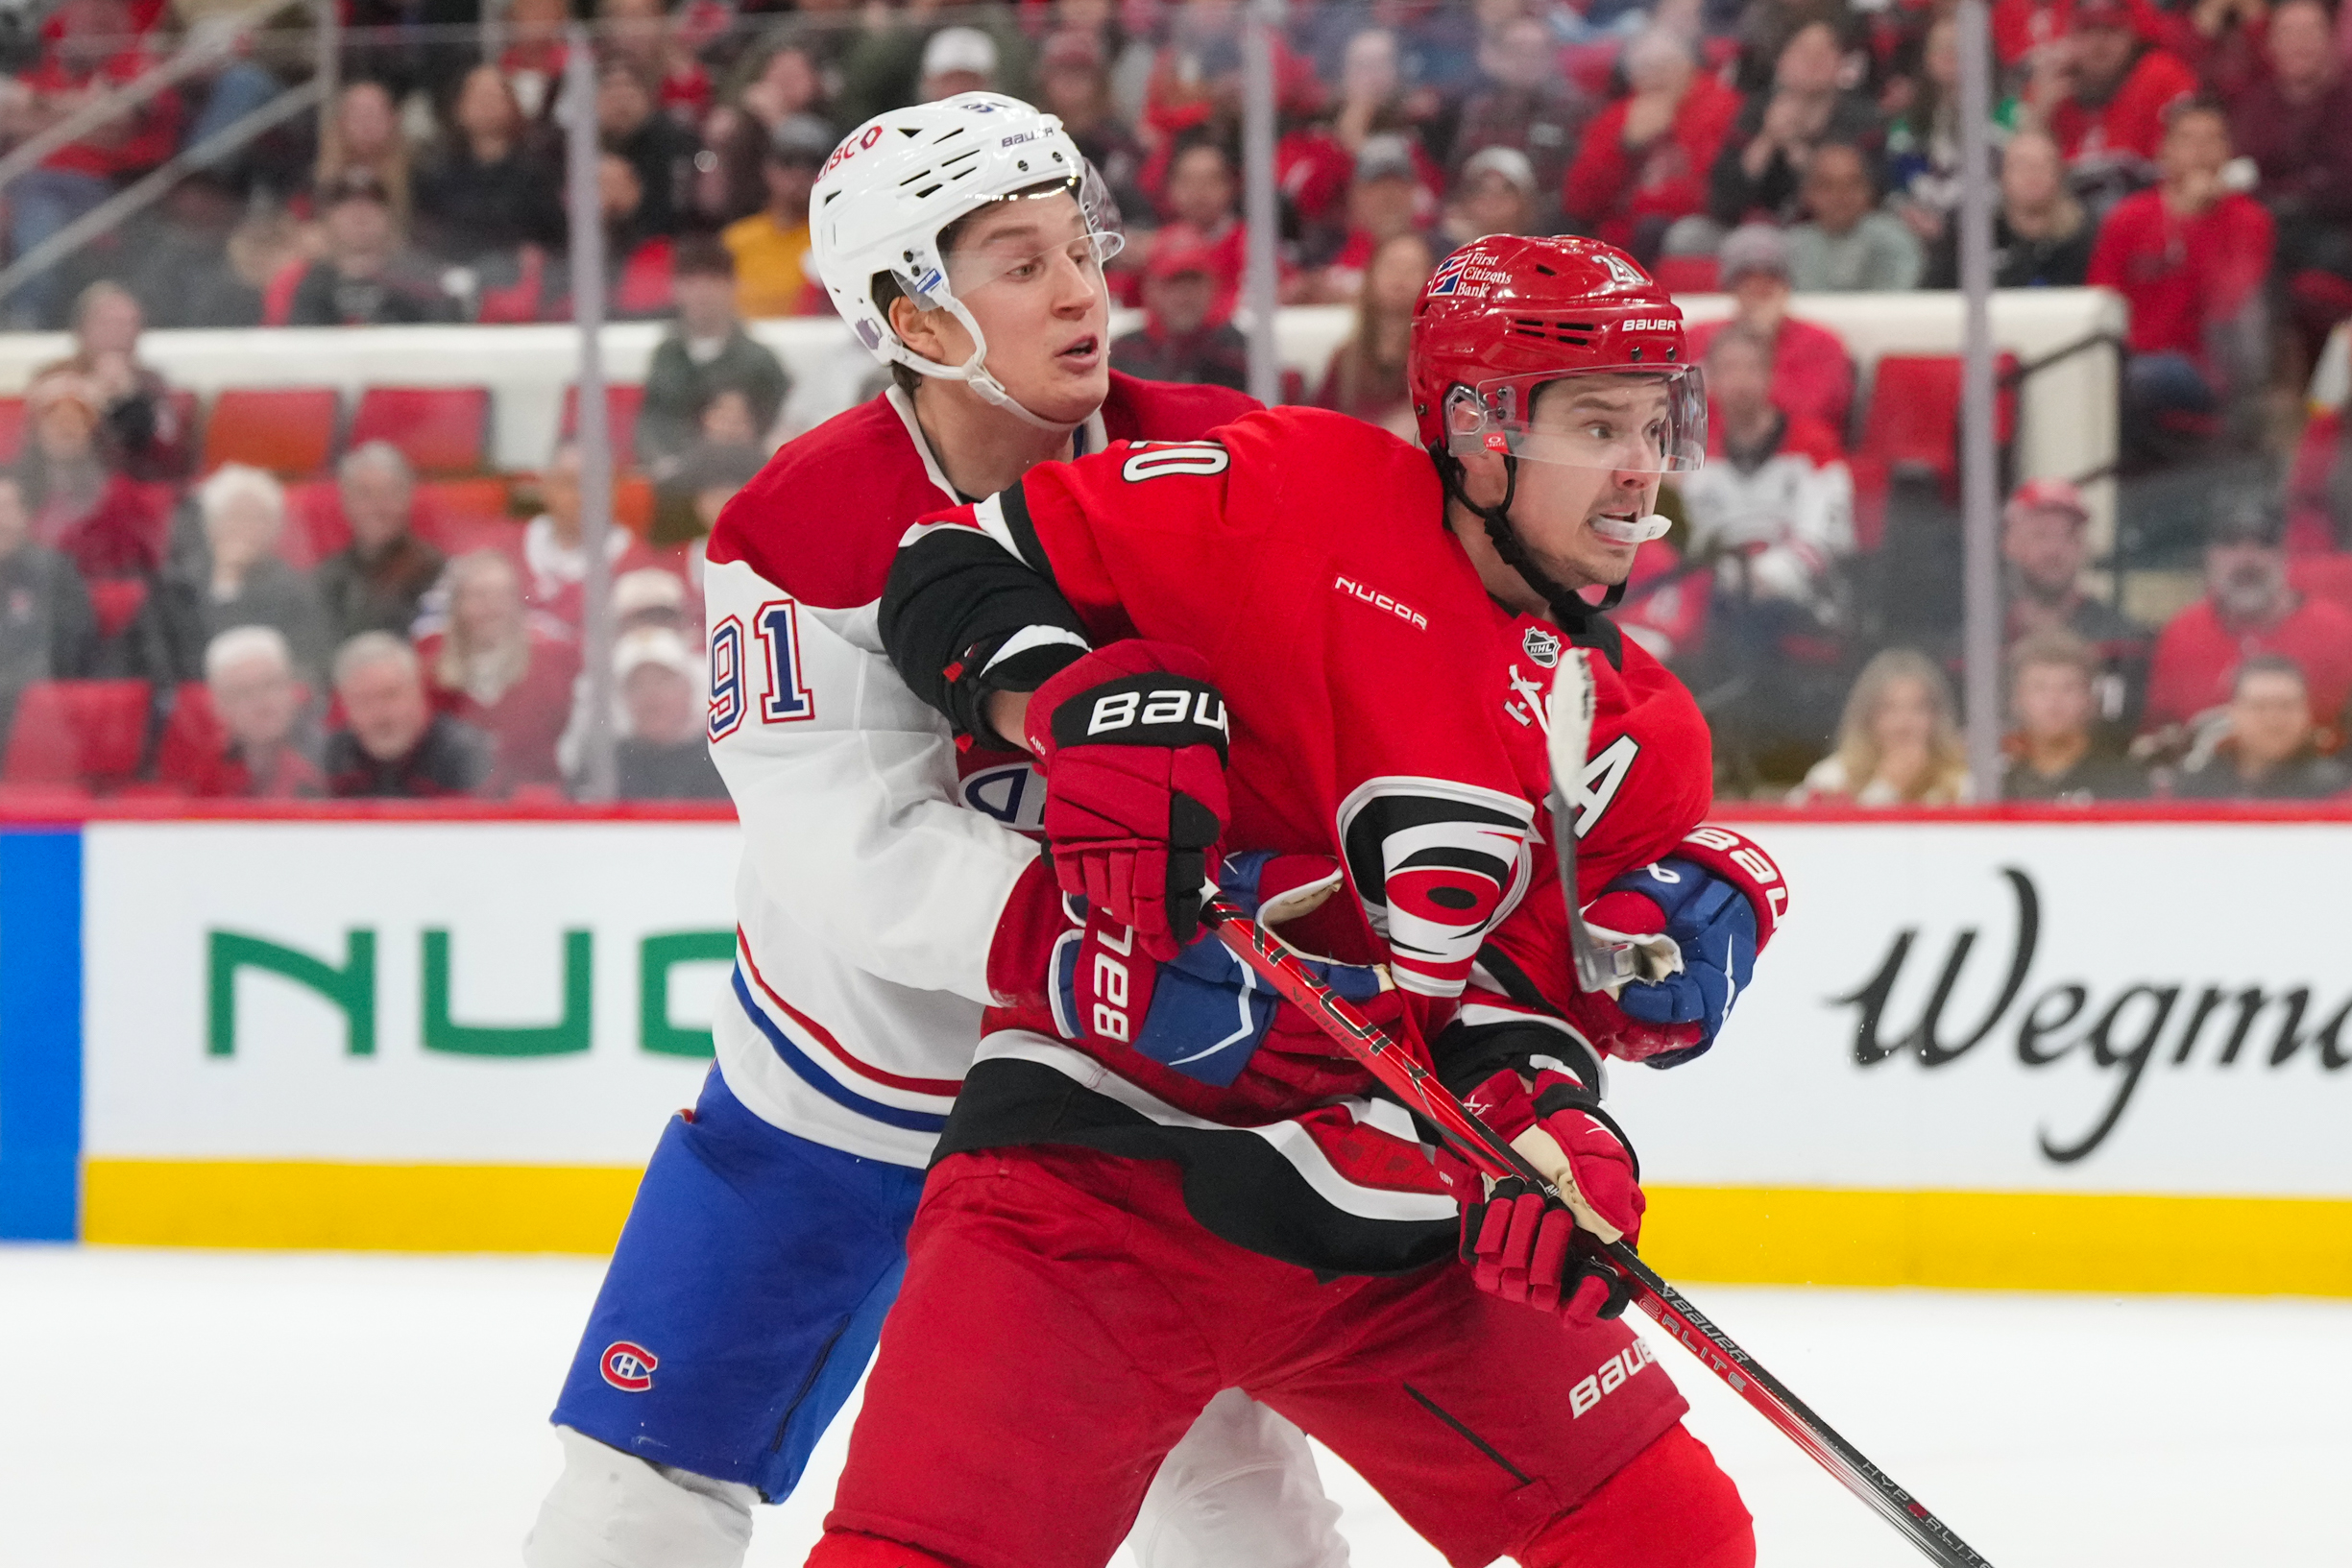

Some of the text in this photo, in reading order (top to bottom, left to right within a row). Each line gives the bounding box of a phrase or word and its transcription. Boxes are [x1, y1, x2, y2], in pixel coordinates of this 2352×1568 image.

[1002, 127, 1054, 148] BAUR
[1468, 252, 1500, 266] First
[1456, 281, 1491, 299] Bank
[1335, 575, 1429, 630] NUCOR
[1530, 642, 1553, 654] NHL
[707, 598, 816, 744] 91
[1086, 689, 1230, 746] BAU
[1573, 732, 1642, 840] A
